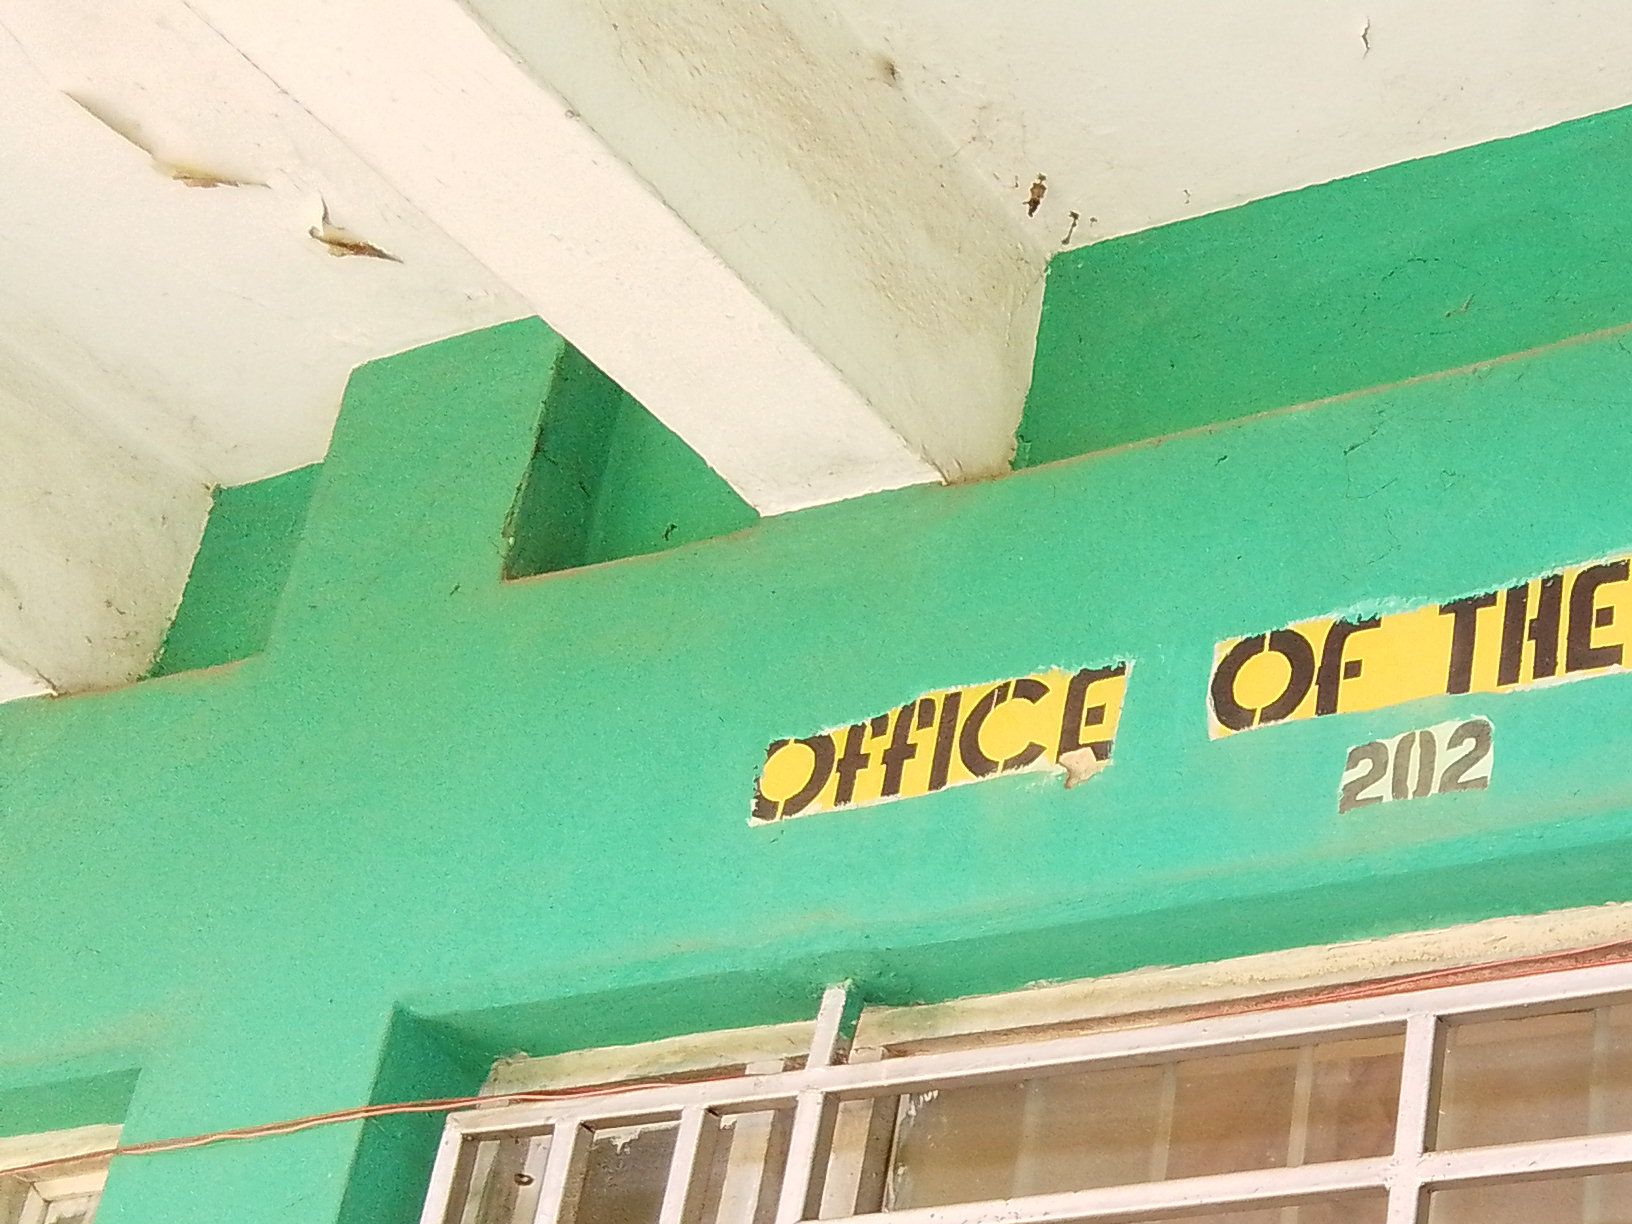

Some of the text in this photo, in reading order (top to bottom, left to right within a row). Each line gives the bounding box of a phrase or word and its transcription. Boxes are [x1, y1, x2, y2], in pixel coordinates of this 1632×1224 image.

[752, 660, 1128, 821] OFFICE
[1210, 615, 1381, 731] OF
[1438, 559, 1631, 695] THE
[1339, 718, 1493, 814] 202
